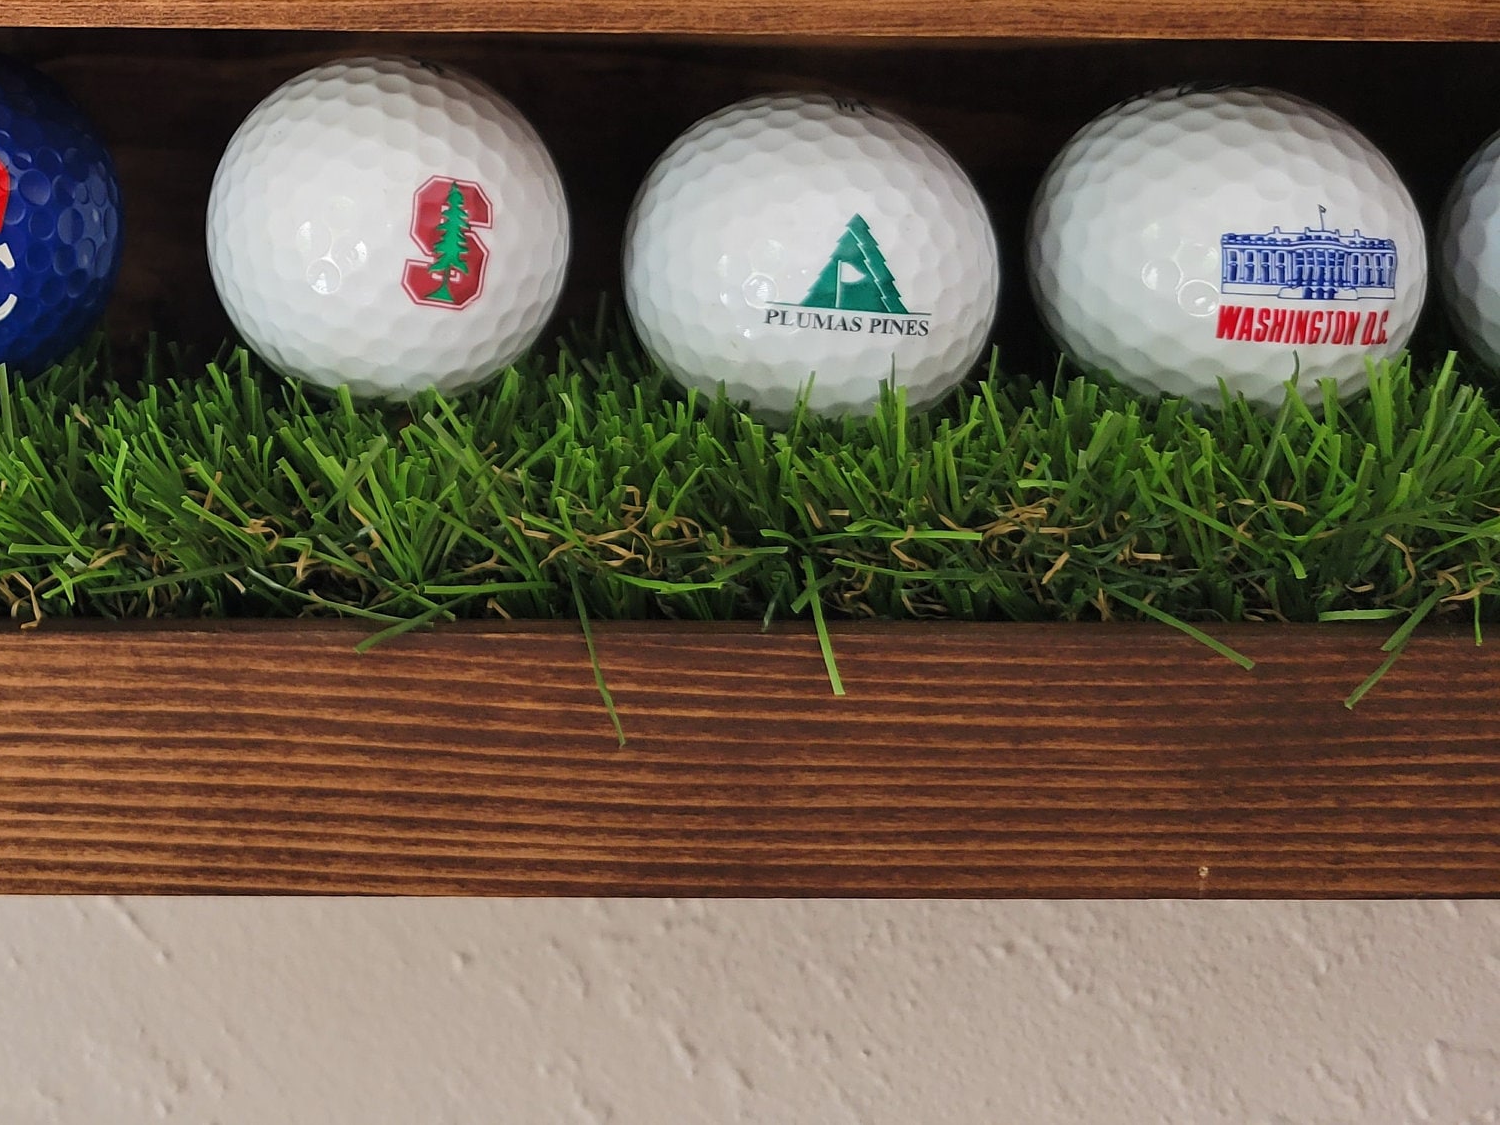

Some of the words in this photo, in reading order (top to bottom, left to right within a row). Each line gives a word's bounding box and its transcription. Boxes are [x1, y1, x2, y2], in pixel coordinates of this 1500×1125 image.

[764, 309, 864, 332] PLUMAS
[868, 317, 931, 336] PINES
[1215, 305, 1361, 346] WASHINGTON
[1360, 309, 1390, 346] D.C.
